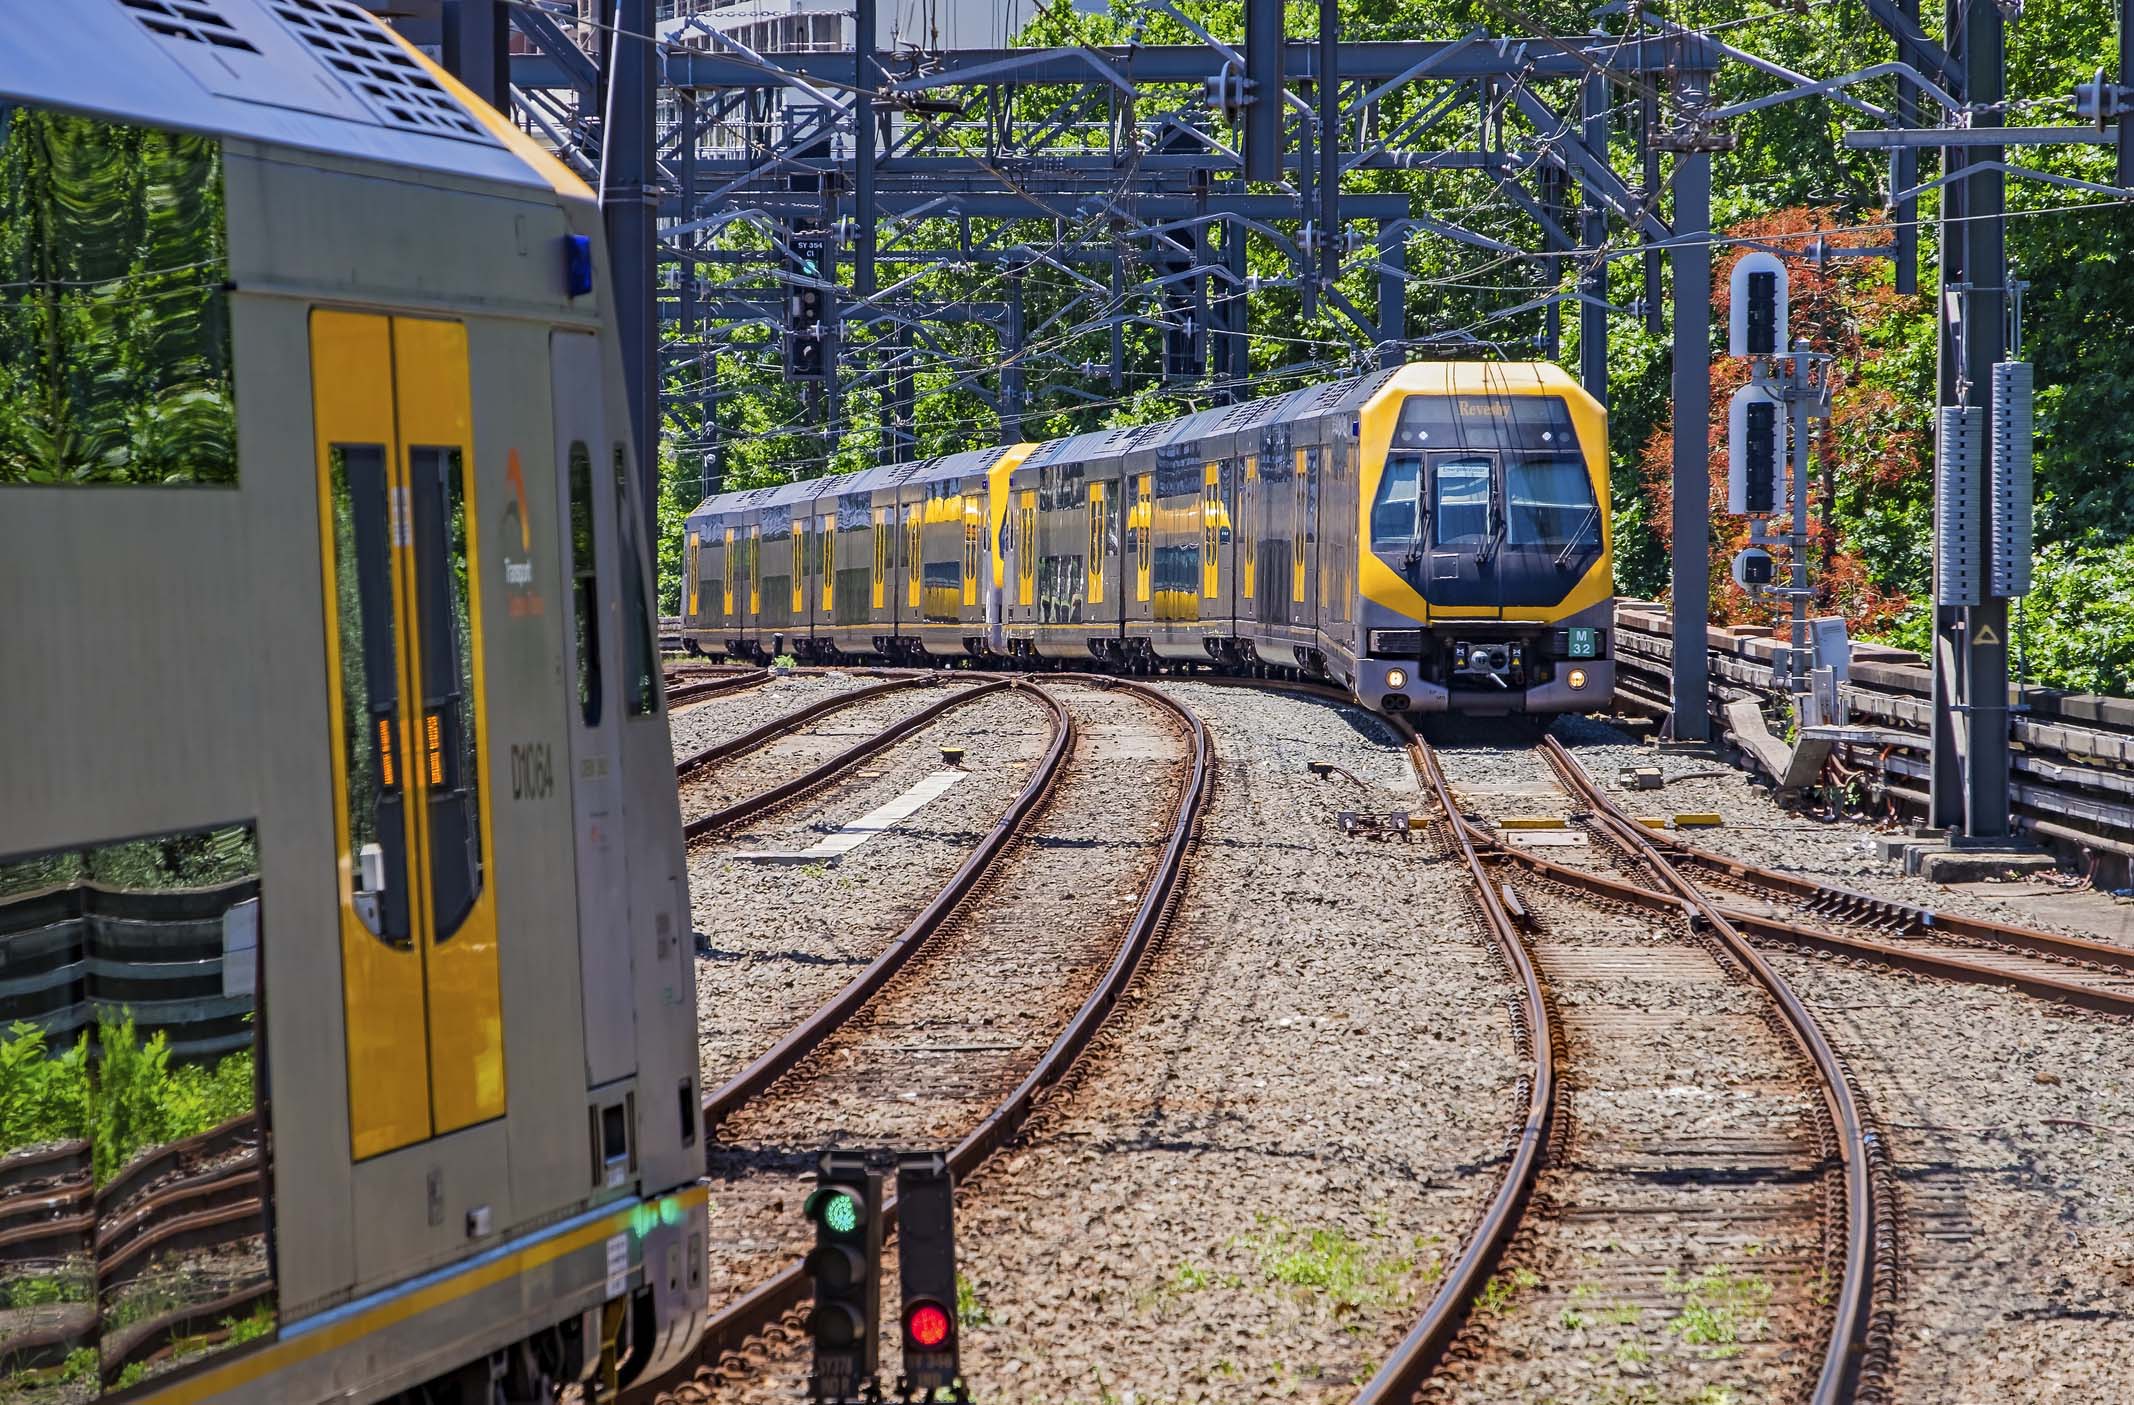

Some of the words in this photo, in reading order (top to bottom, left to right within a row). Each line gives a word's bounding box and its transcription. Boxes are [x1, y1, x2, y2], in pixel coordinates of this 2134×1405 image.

[1576, 630, 1587, 641] M
[1573, 643, 1591, 654] 32
[511, 742, 554, 801] D1064
